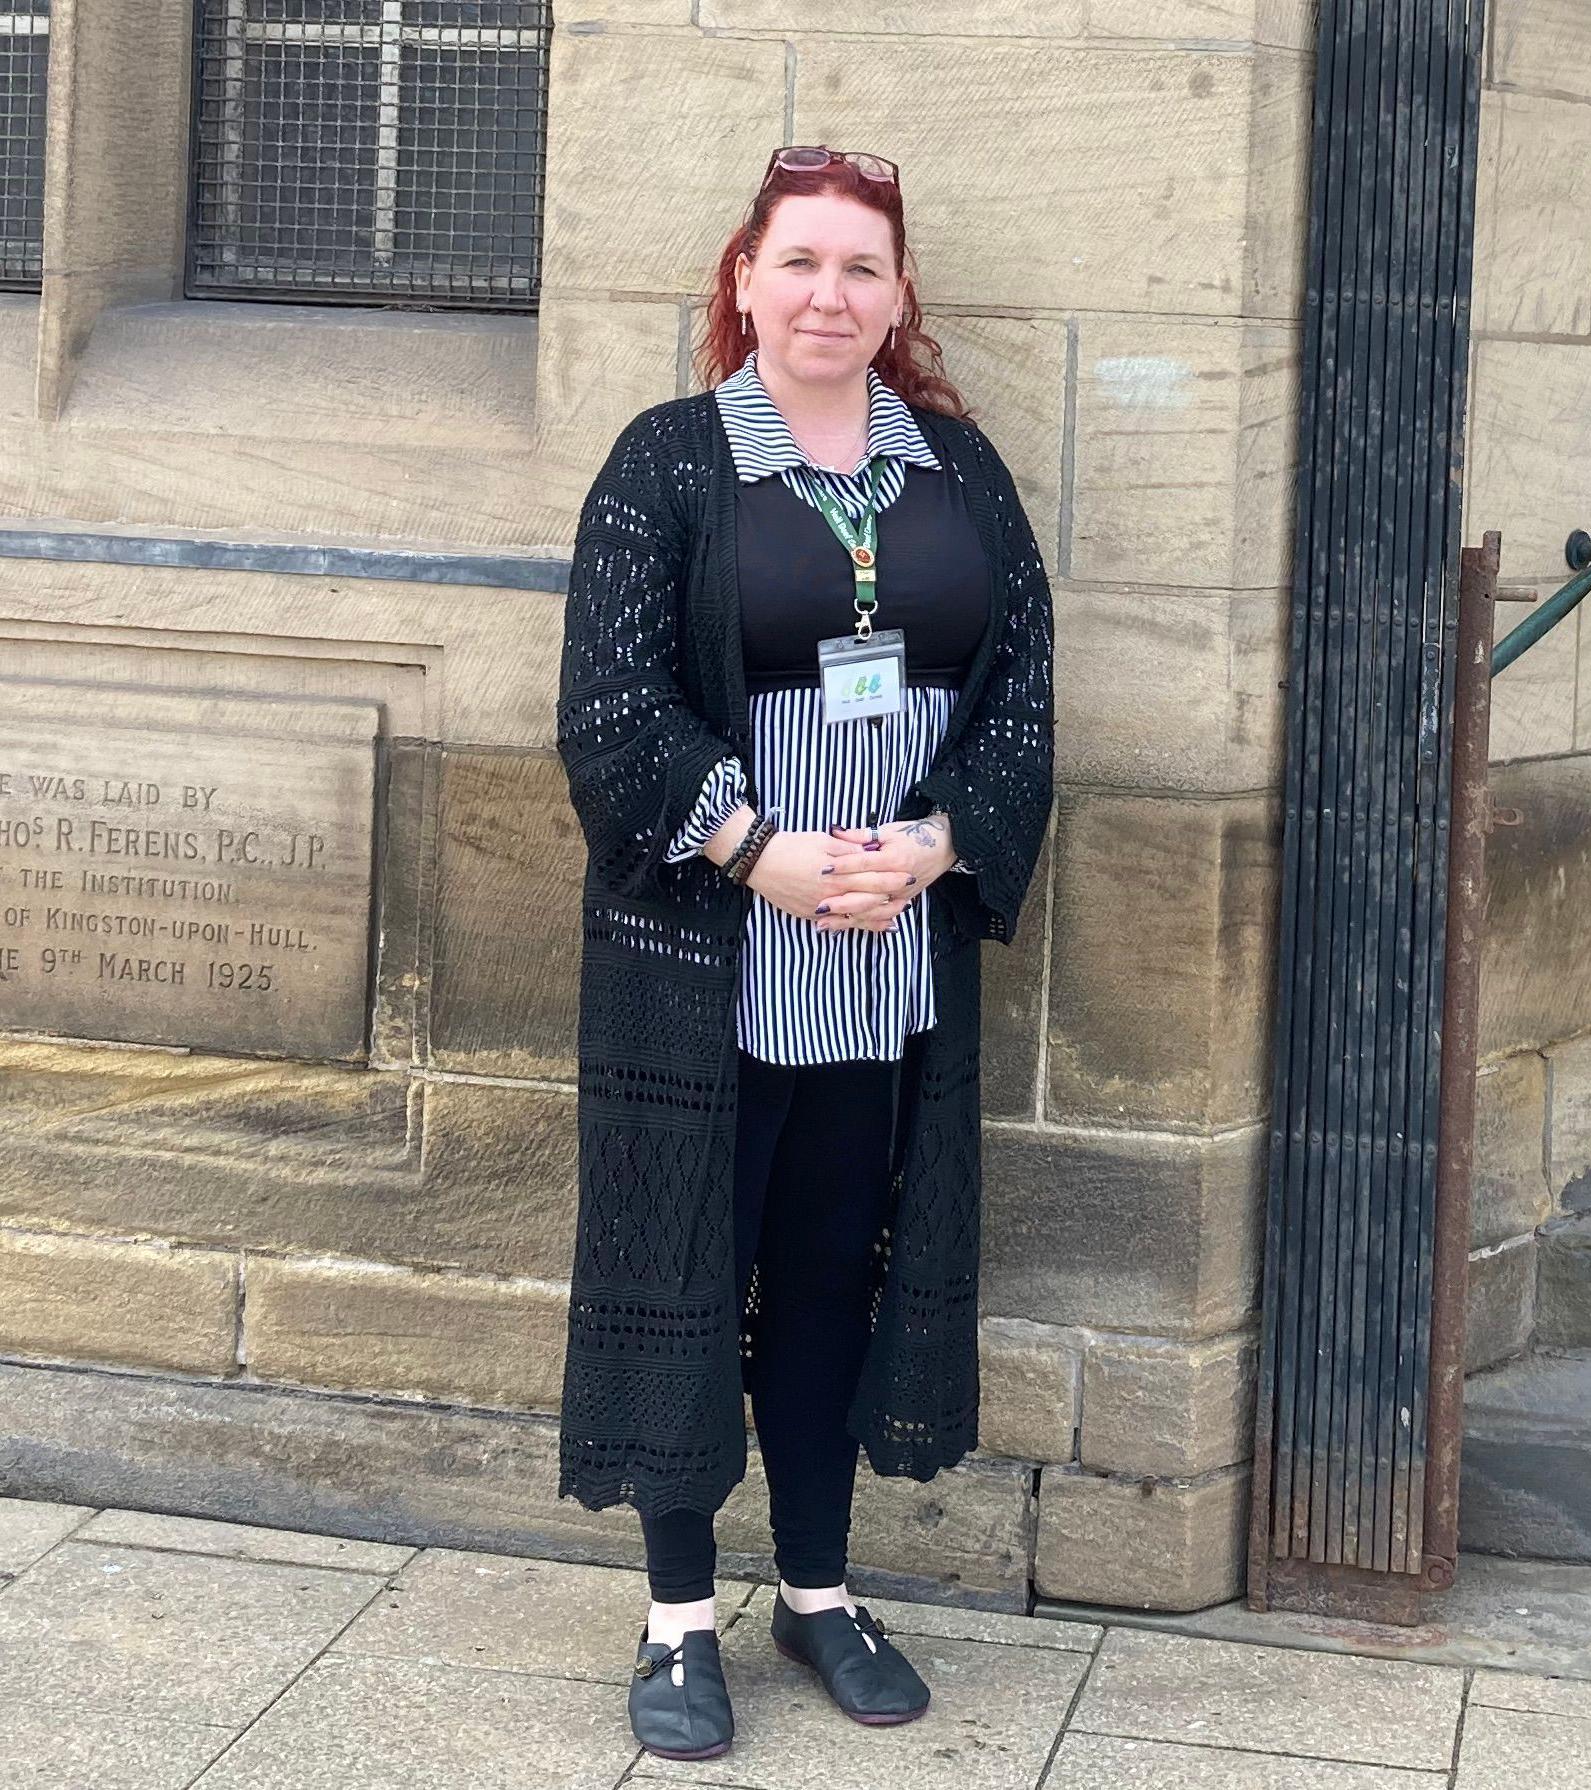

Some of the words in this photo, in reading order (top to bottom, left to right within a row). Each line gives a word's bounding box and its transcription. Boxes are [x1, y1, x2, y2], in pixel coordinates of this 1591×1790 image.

[29, 774, 86, 802] WAS
[103, 779, 161, 806] LAID
[182, 784, 219, 810] BY
[20, 868, 64, 889] THE
[4, 907, 31, 928] OF
[98, 952, 186, 985] MARCH
